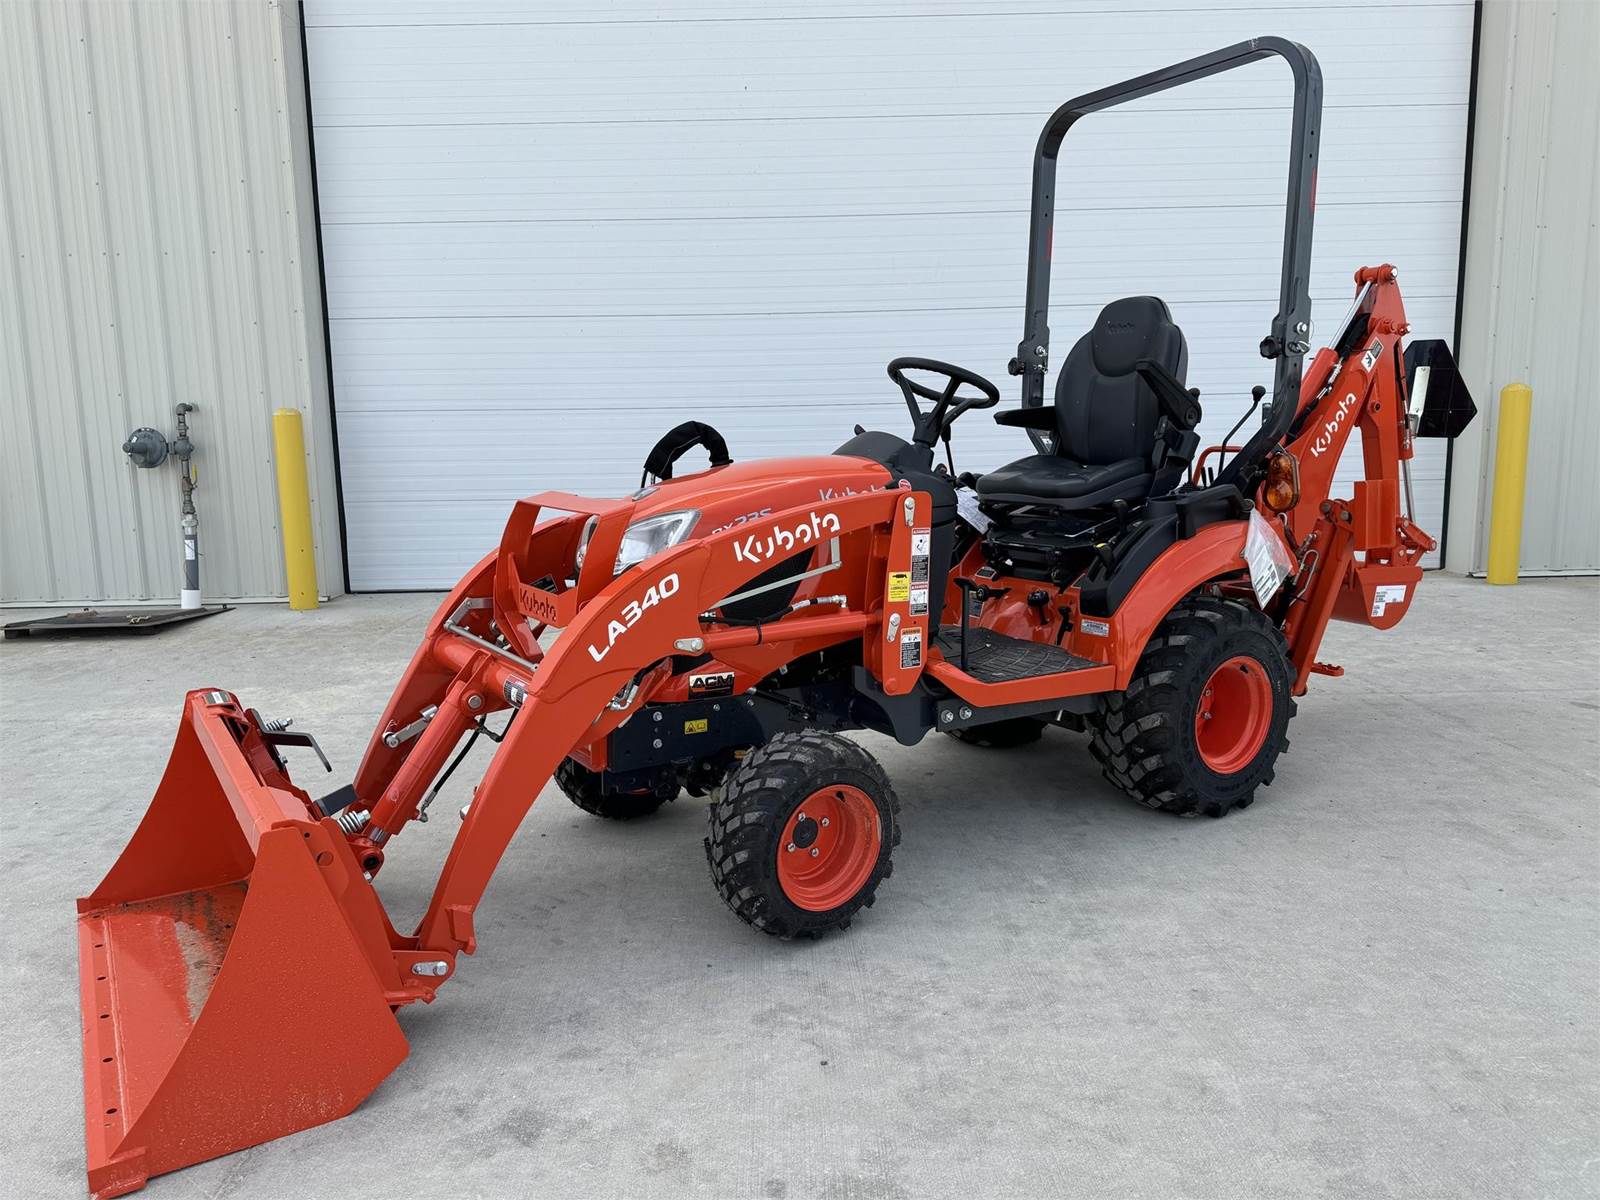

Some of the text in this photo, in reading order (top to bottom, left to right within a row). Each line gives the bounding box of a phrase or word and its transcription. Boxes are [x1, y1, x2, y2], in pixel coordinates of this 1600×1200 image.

[1310, 393, 1357, 457] Kubota
[733, 511, 841, 563] Kubota
[520, 588, 557, 622] Kubota
[587, 572, 680, 662] LA340
[691, 674, 734, 689] ACM
